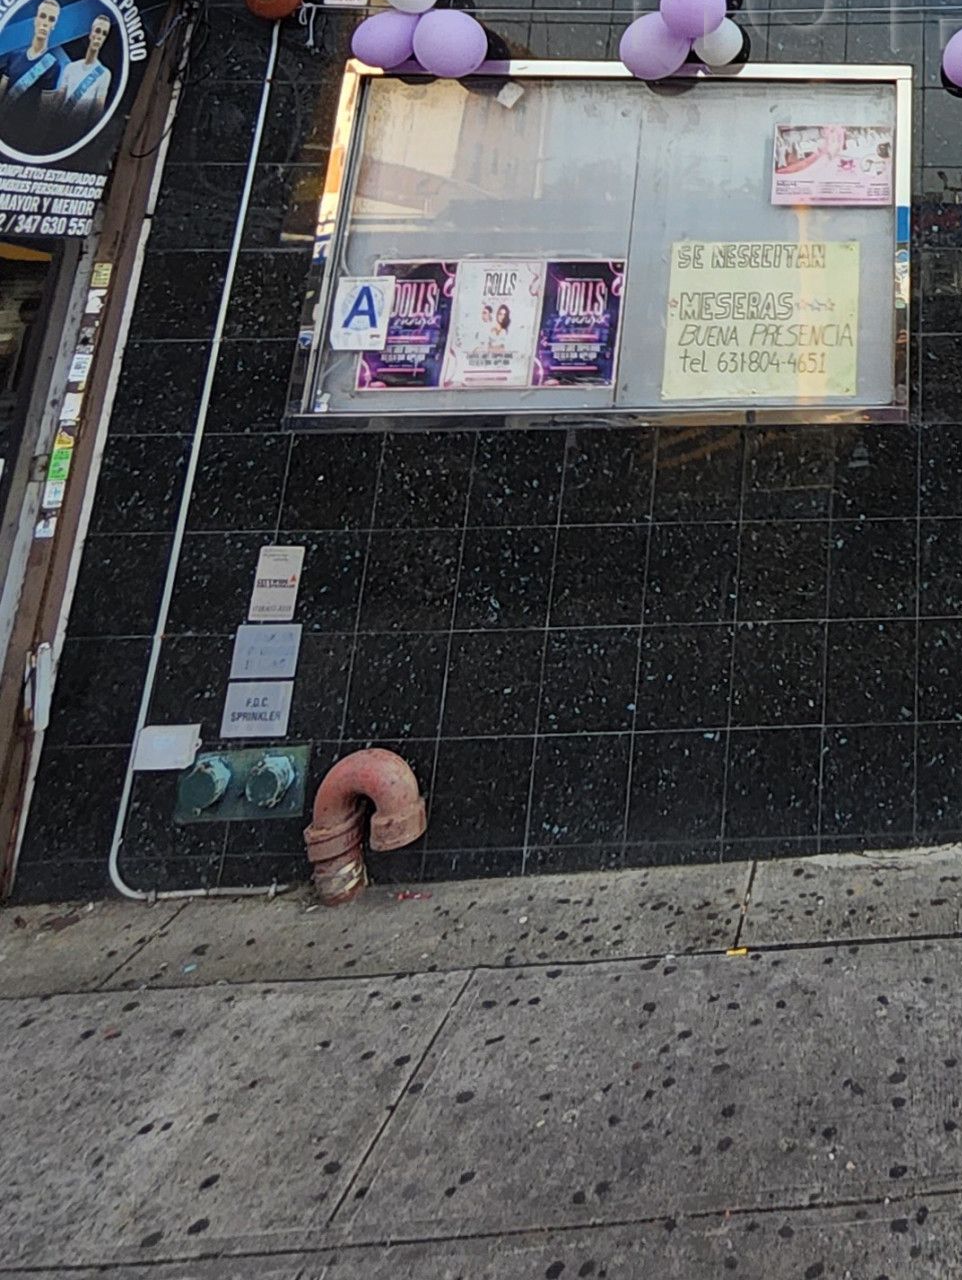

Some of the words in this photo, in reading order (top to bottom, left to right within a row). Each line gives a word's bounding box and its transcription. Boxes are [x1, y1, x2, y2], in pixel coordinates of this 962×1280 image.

[0, 193, 41, 212] MAYOR
[42, 197, 53, 214] Y
[50, 198, 95, 216] MENOR
[14, 213, 42, 233] 347
[40, 216, 67, 235] 630
[677, 244, 705, 270] SE
[483, 272, 518, 297] DOLLS
[341, 285, 379, 329] A
[557, 280, 606, 317] DOLLS
[679, 292, 794, 321] MESERAS
[678, 323, 740, 347] BUENA
[749, 323, 854, 347] PRESENCIA
[230, 710, 281, 723] SPRINKLER
